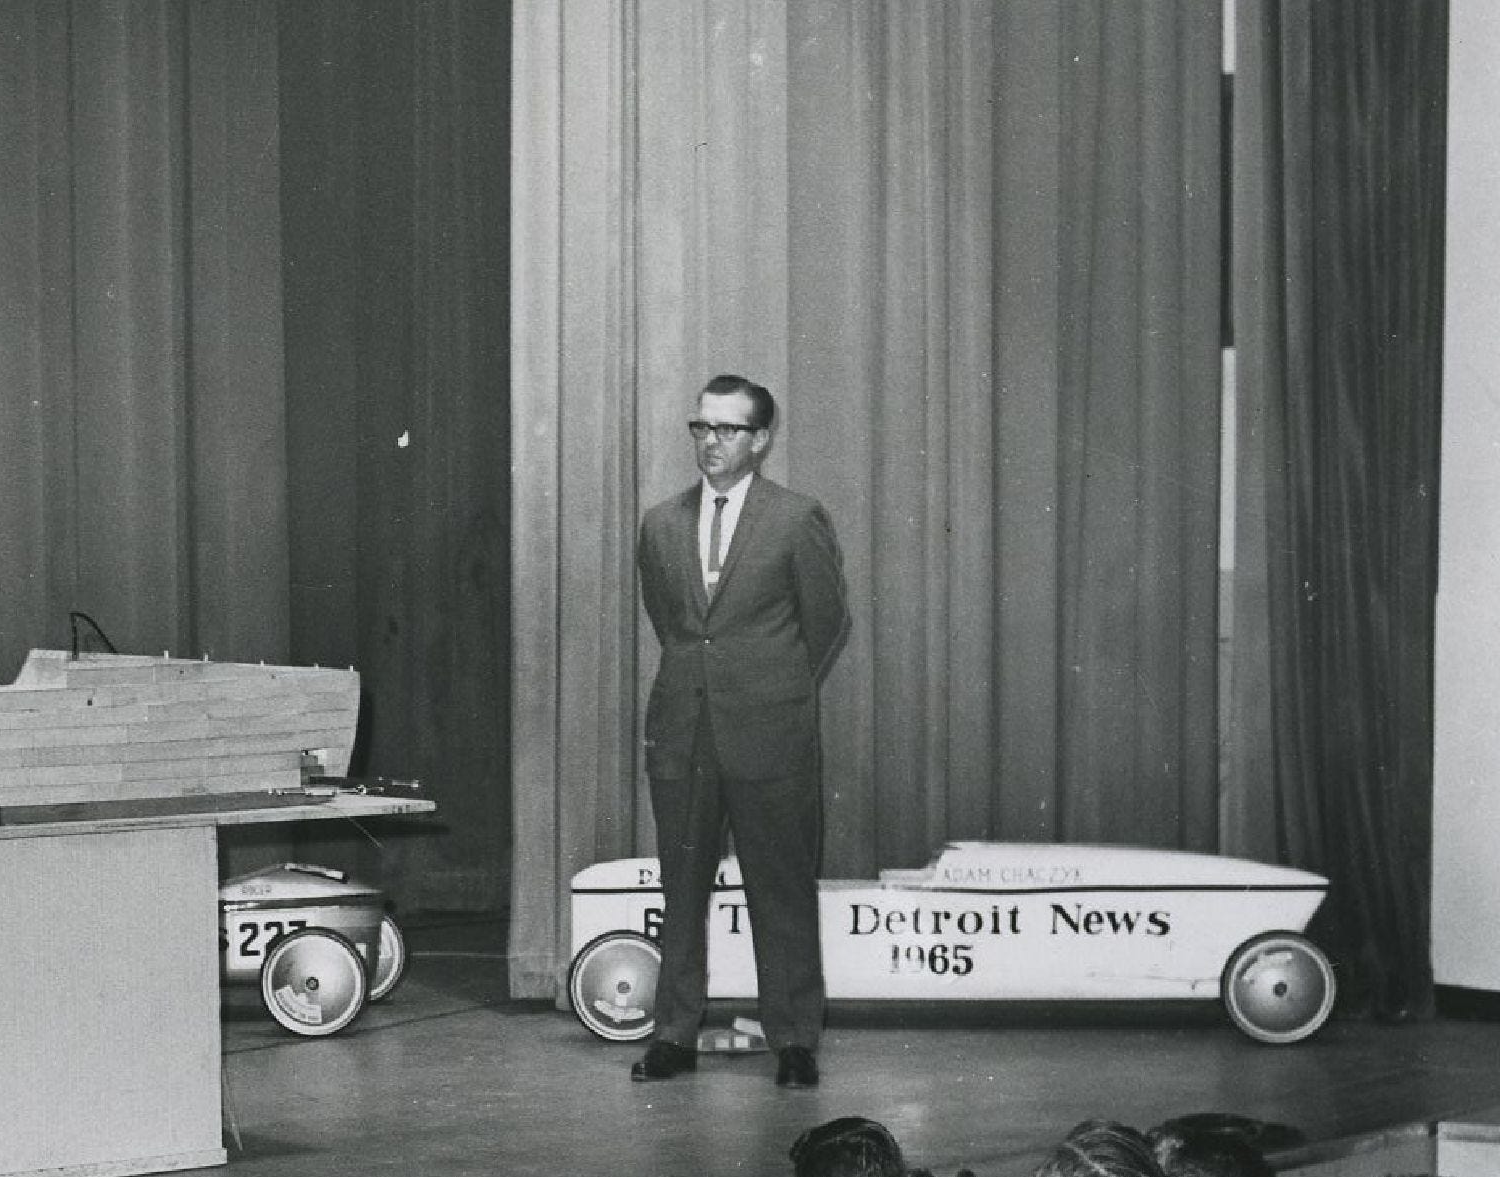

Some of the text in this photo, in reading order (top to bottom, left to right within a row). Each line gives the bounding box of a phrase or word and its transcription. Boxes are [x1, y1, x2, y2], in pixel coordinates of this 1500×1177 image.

[849, 903, 1171, 936] Detroit News
[889, 943, 975, 976] 1965
